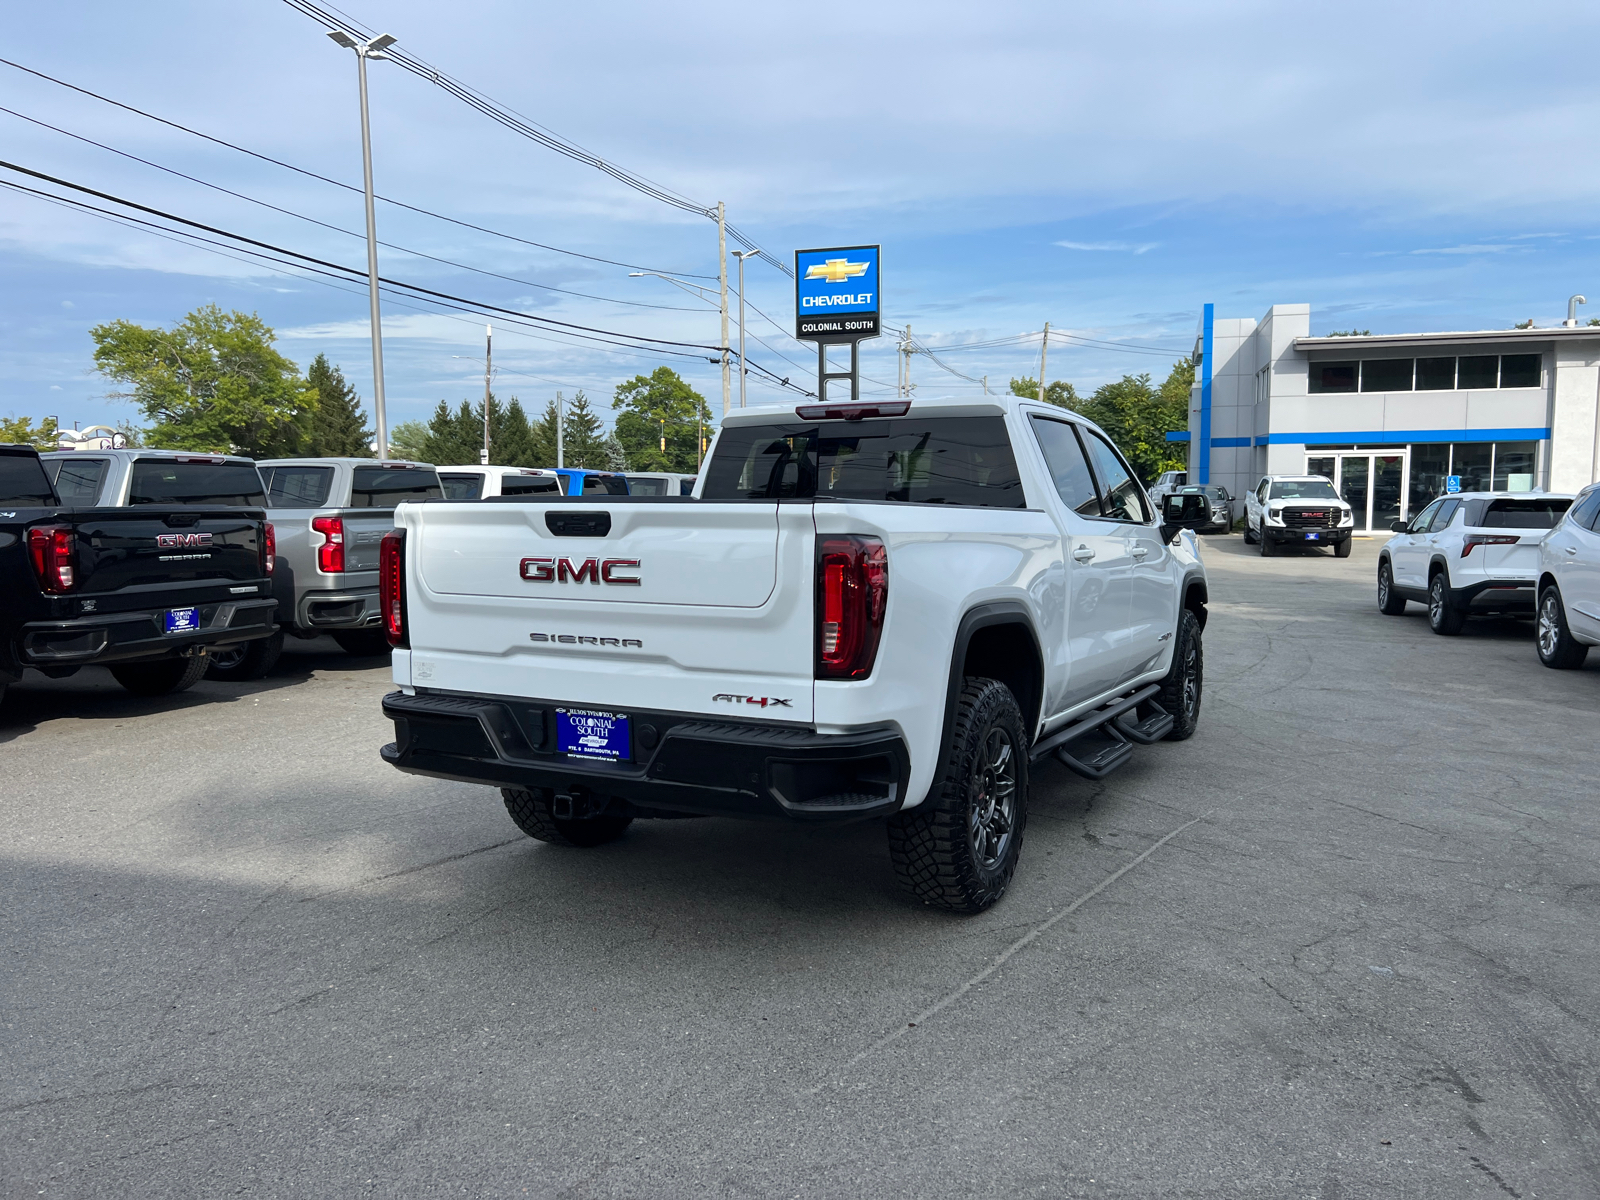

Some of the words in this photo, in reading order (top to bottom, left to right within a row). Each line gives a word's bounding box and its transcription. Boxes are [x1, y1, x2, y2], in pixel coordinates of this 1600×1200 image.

[802, 293, 873, 307] CHEVROLET
[802, 322, 843, 332] COLONIAL
[845, 321, 873, 330] SOUTH
[156, 533, 213, 547] GMC
[158, 554, 212, 562] SIERRA
[519, 556, 641, 587] GMC
[529, 632, 643, 648] SIERRA
[712, 693, 793, 708] AT4X
[570, 716, 615, 729] COLONIAL
[577, 726, 608, 737] SOUTH
